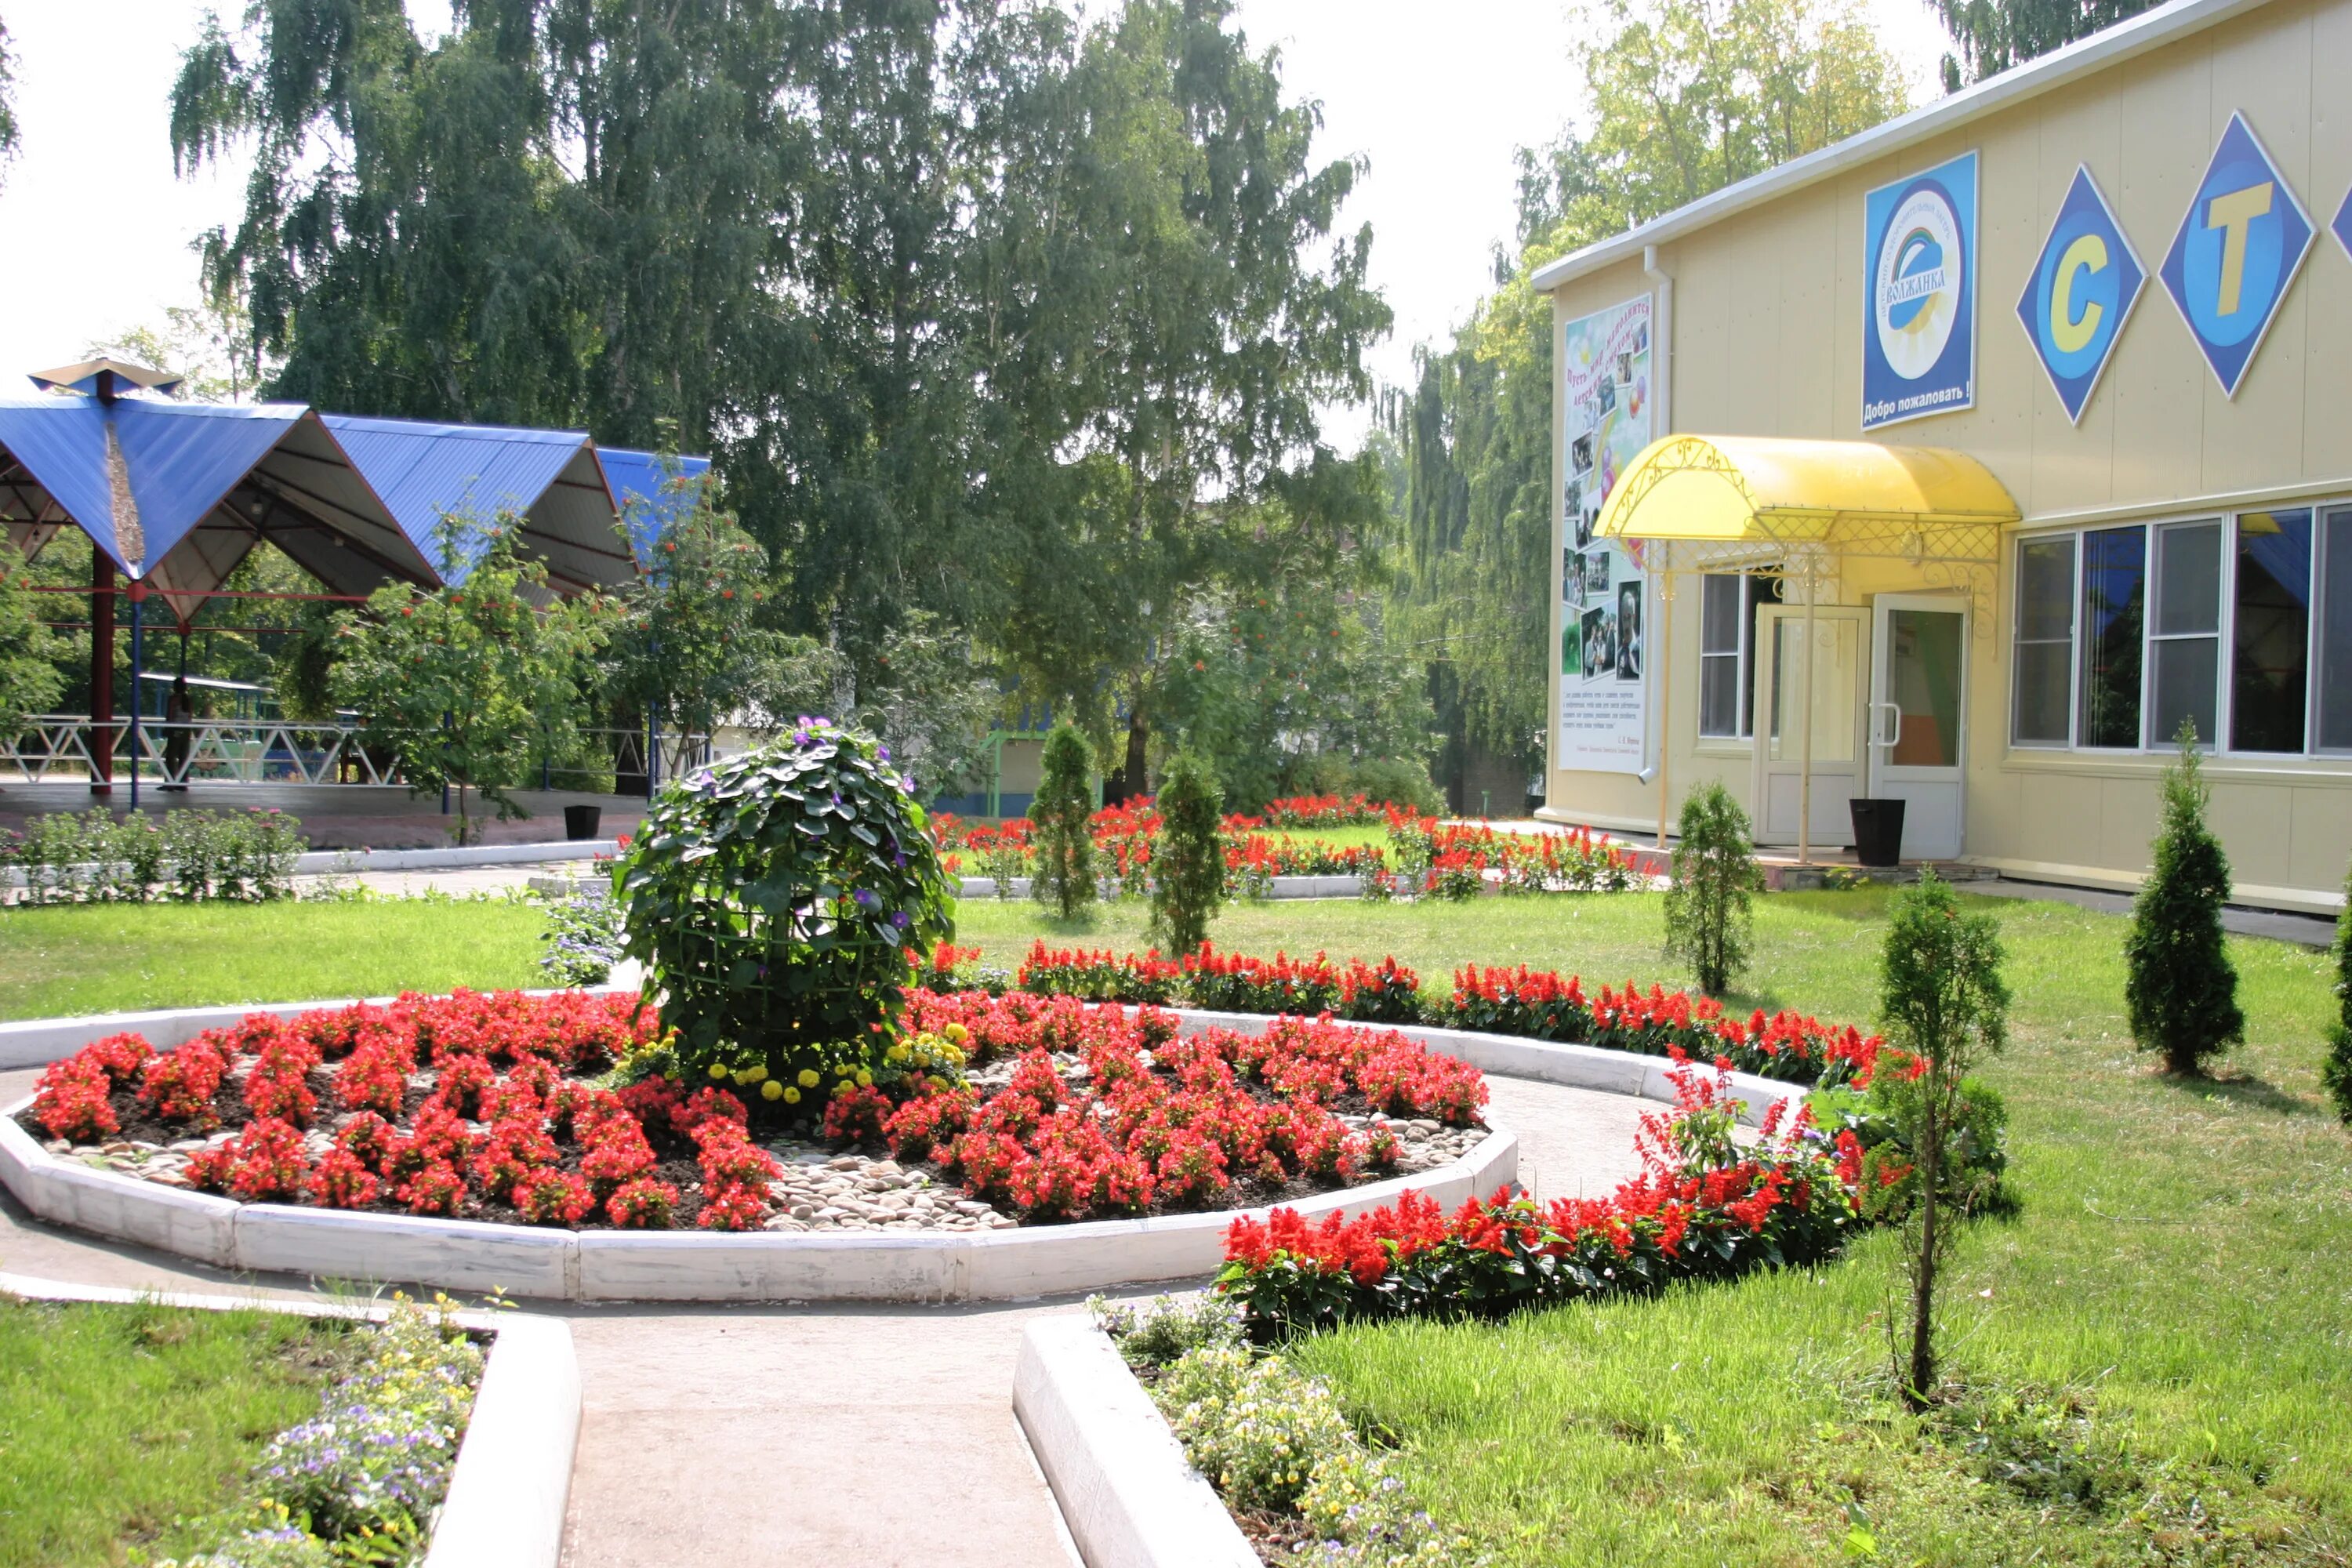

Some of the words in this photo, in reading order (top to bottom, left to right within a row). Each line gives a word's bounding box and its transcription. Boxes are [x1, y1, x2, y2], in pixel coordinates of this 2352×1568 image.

[1886, 269, 1946, 304] ВОЛЖАНКА
[1567, 368, 1588, 388] Пусть
[1590, 350, 1604, 375] мир
[1606, 303, 1650, 347] наполнится
[1573, 372, 1602, 407] детским
[1864, 400, 1896, 424] Добро
[1897, 387, 1963, 412] пожаловать
